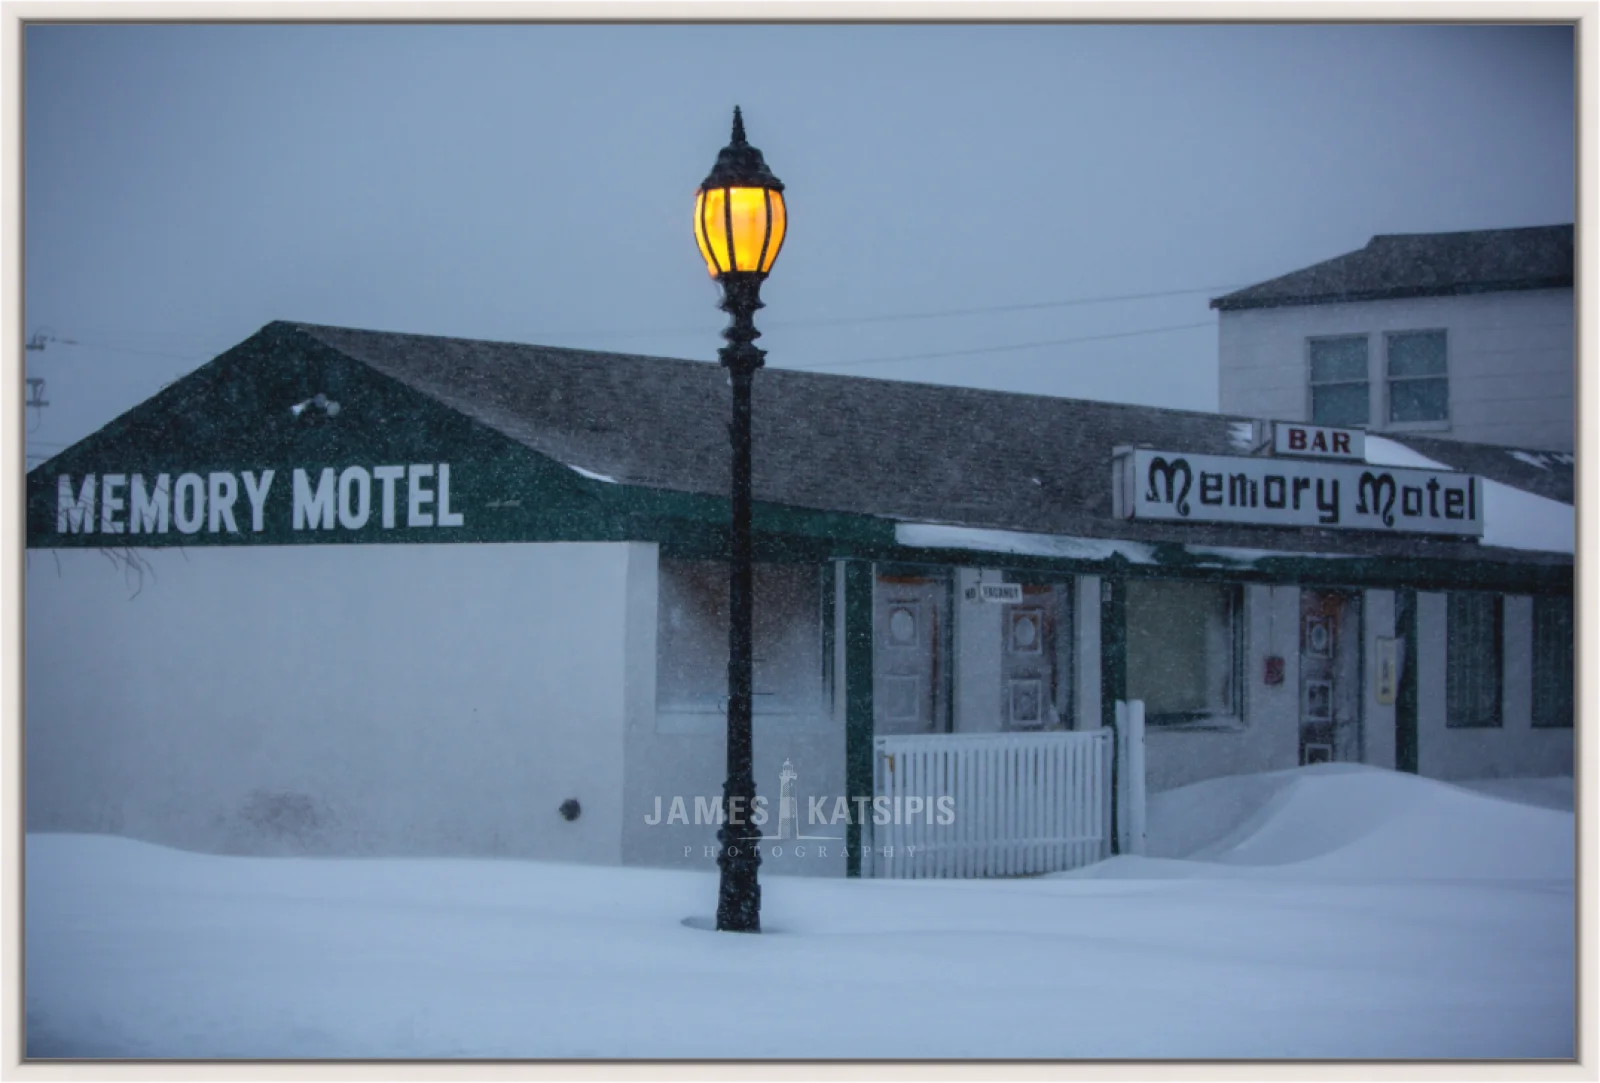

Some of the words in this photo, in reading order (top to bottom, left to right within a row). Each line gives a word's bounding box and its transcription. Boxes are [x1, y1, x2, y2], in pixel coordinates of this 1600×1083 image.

[1288, 428, 1351, 455] BAR
[57, 469, 276, 535] MEMORY
[292, 463, 464, 531] MOTEL
[1145, 456, 1339, 525] Memory
[1356, 471, 1475, 528] Motel
[982, 586, 1018, 599] VACANCY
